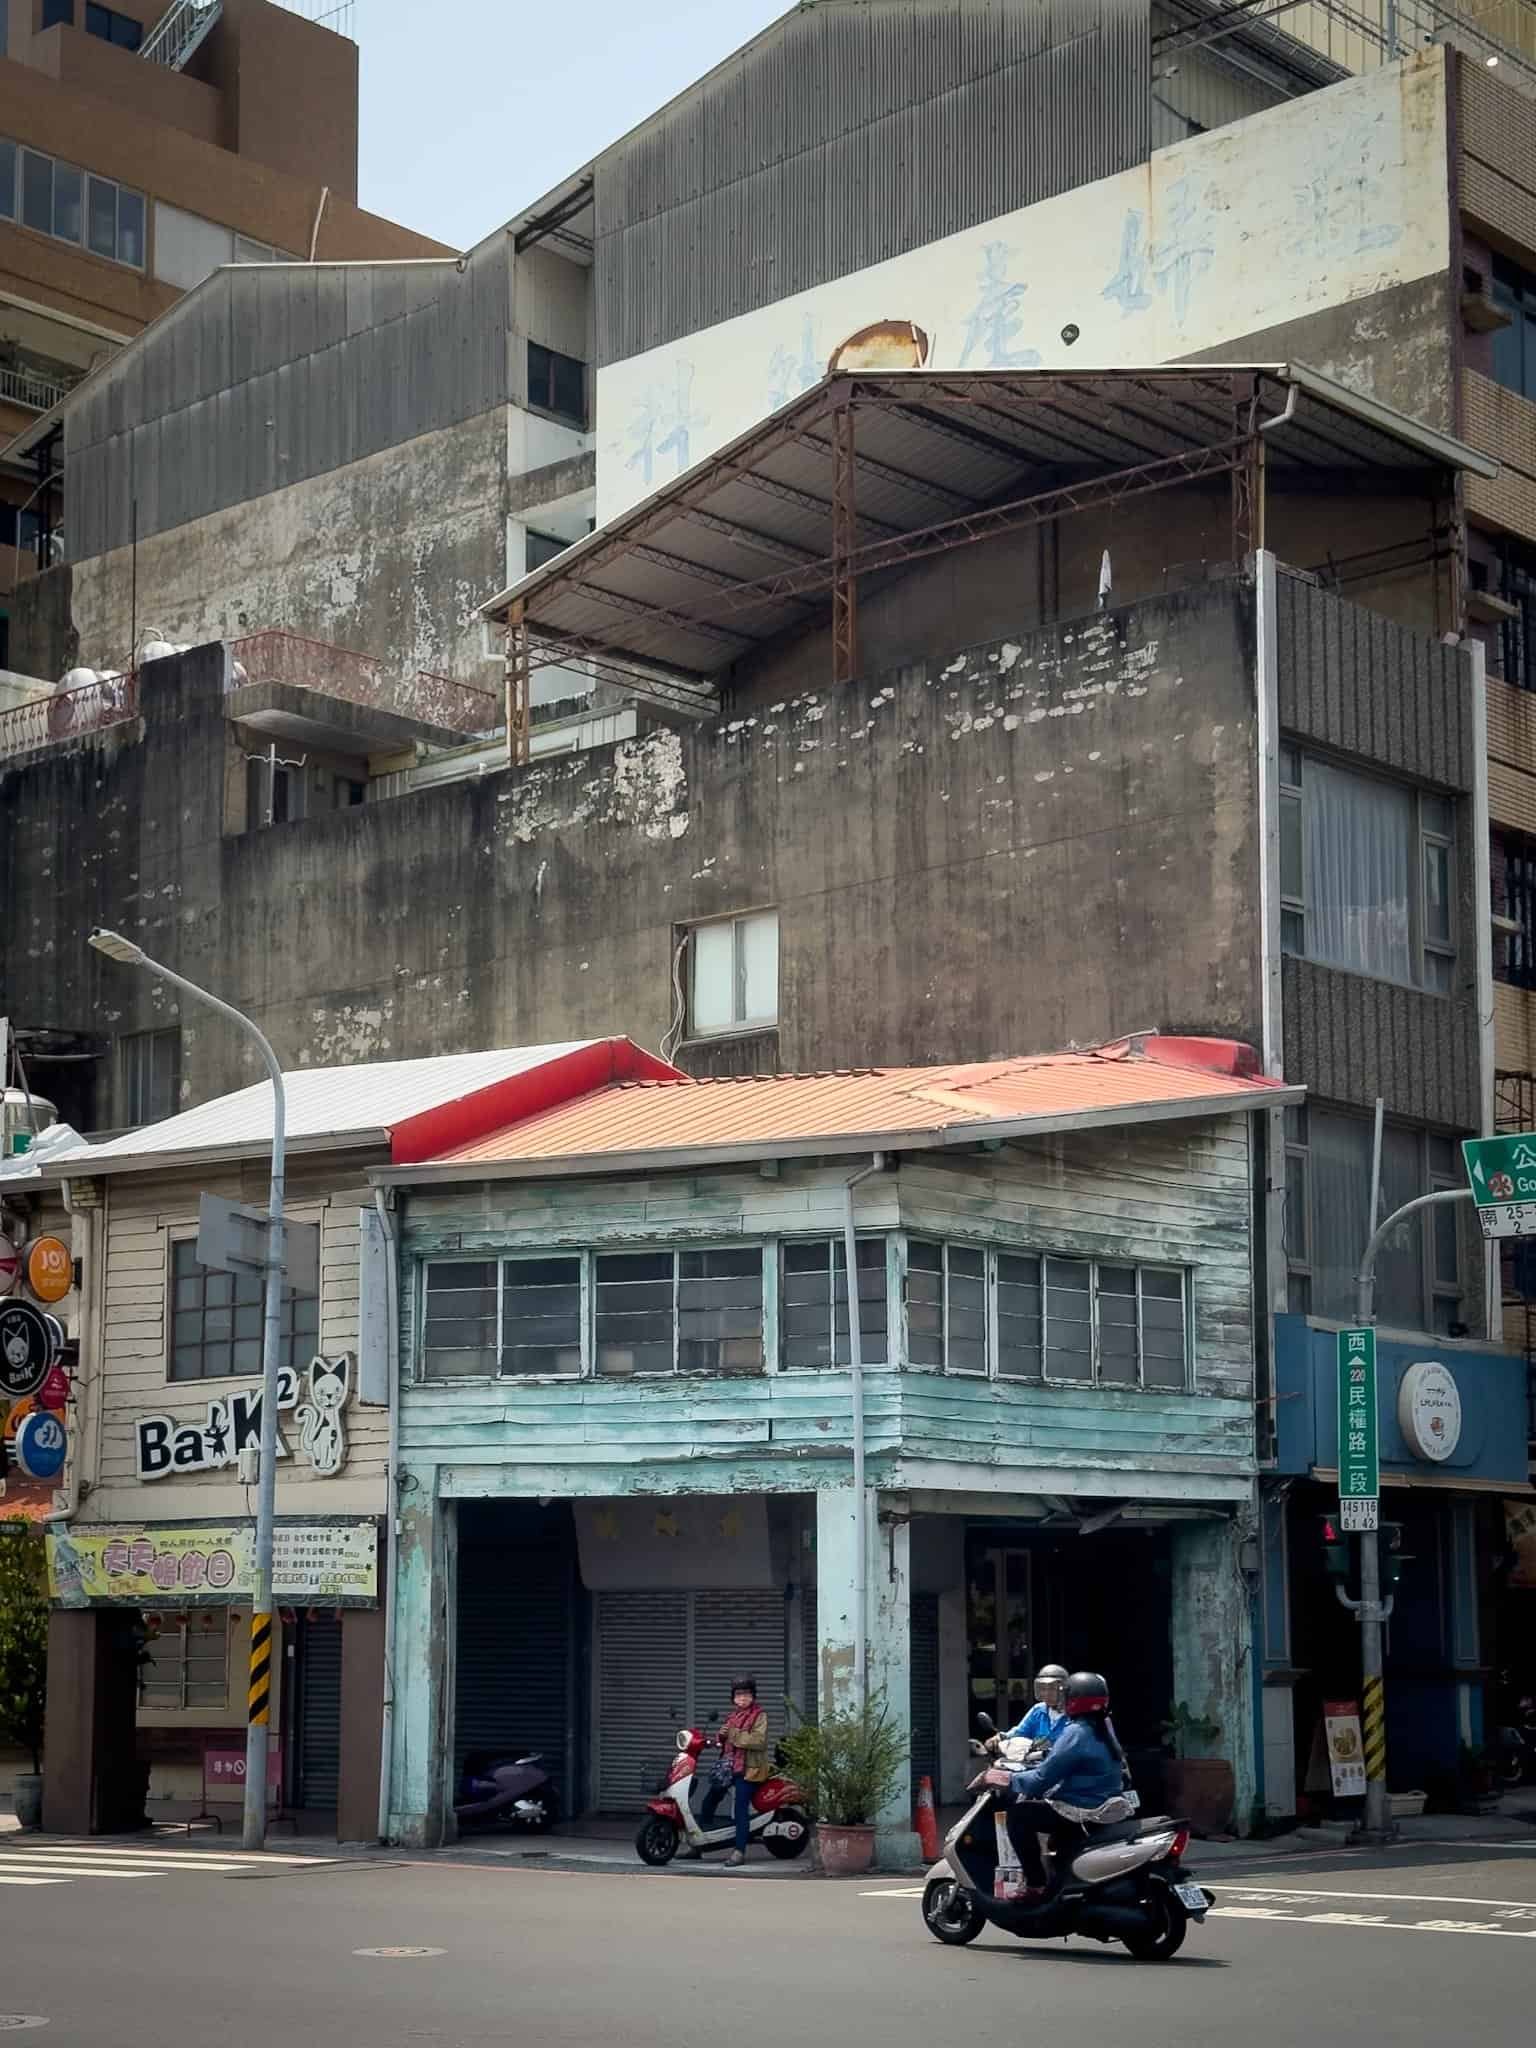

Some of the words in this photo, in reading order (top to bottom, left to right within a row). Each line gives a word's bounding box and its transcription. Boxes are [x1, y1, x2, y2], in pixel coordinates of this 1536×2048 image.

[1512, 1144, 1536, 1169] 公
[1480, 1209, 1497, 1225] 南
[1506, 1206, 1536, 1220] 25-
[1348, 1333, 1365, 1352] 西
[1348, 1386, 1368, 1493] 民權路二段
[1362, 1517, 1375, 1529] 42
